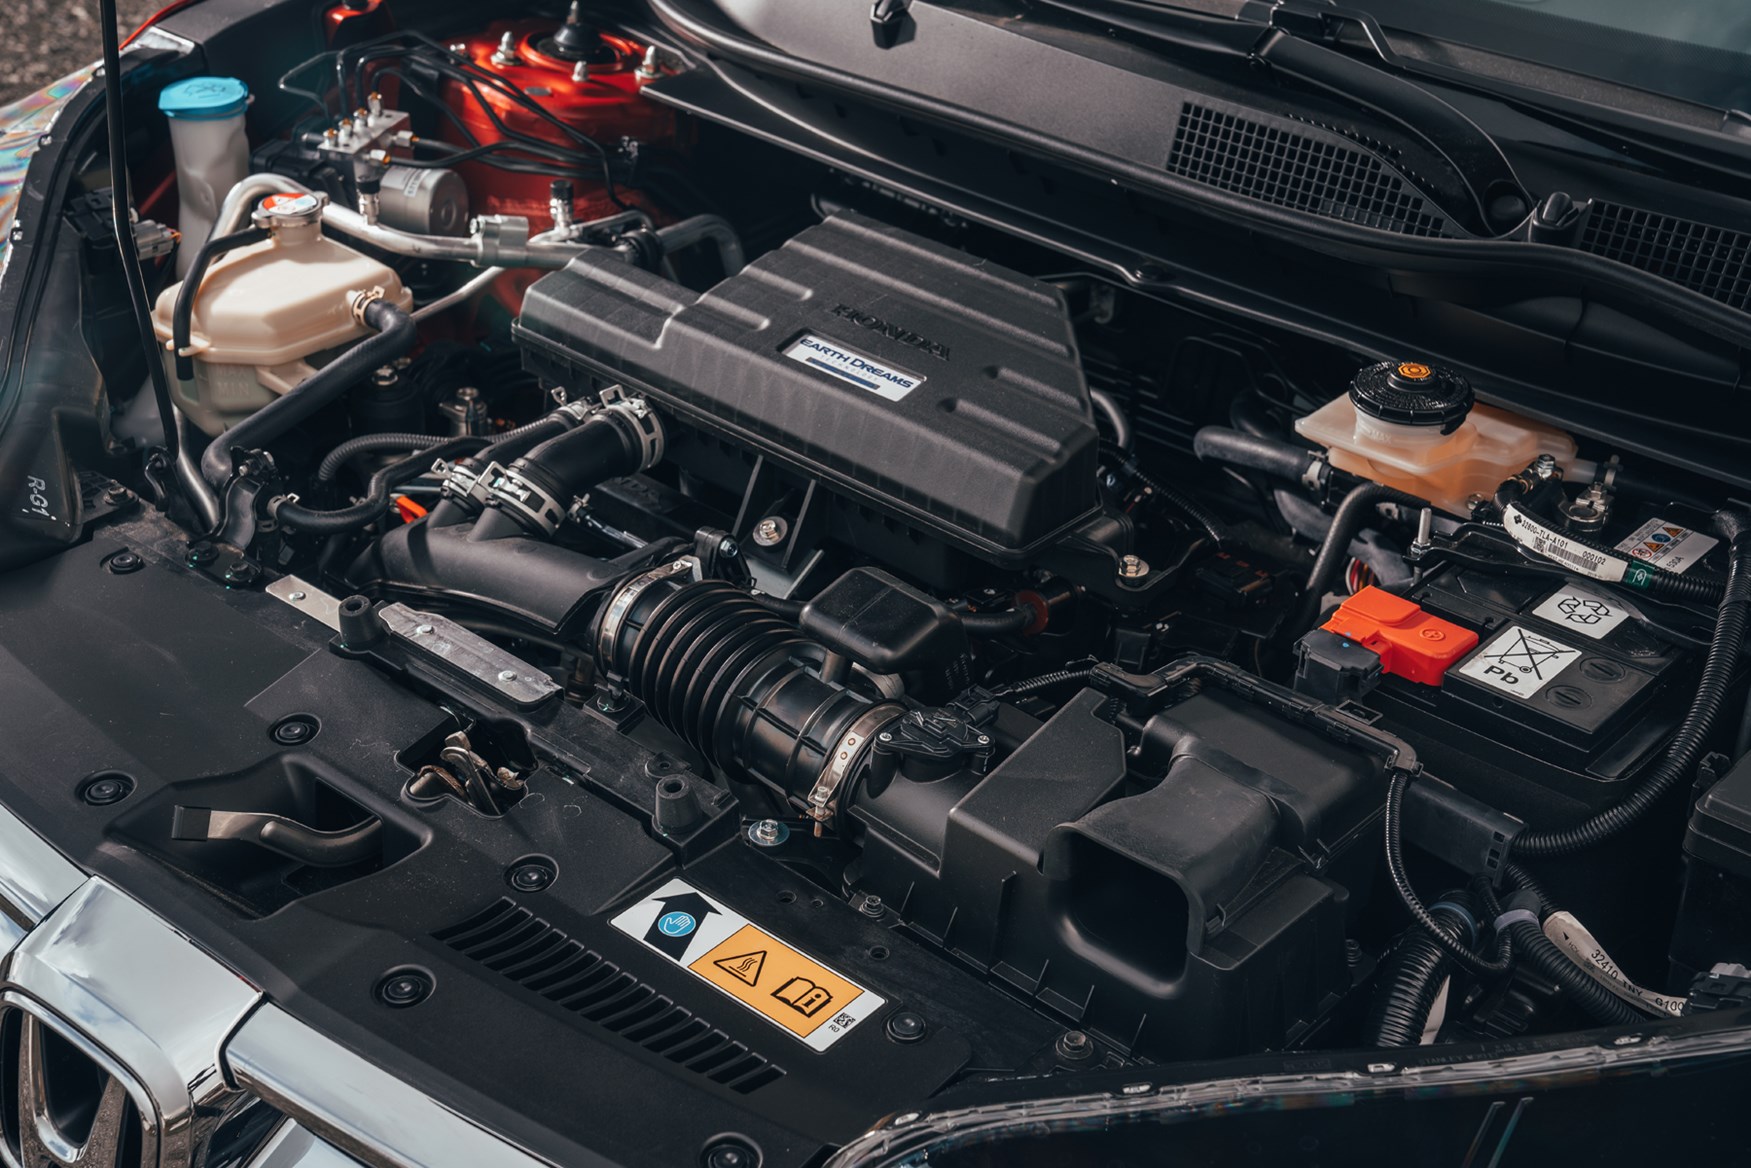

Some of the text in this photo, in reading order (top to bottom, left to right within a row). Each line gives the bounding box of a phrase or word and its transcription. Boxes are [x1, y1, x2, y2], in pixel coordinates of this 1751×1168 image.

[831, 303, 950, 361] HONDA
[801, 338, 914, 389] EARTH DREAMS
[1483, 665, 1519, 685] Pb
[1591, 949, 1619, 980] 32410
